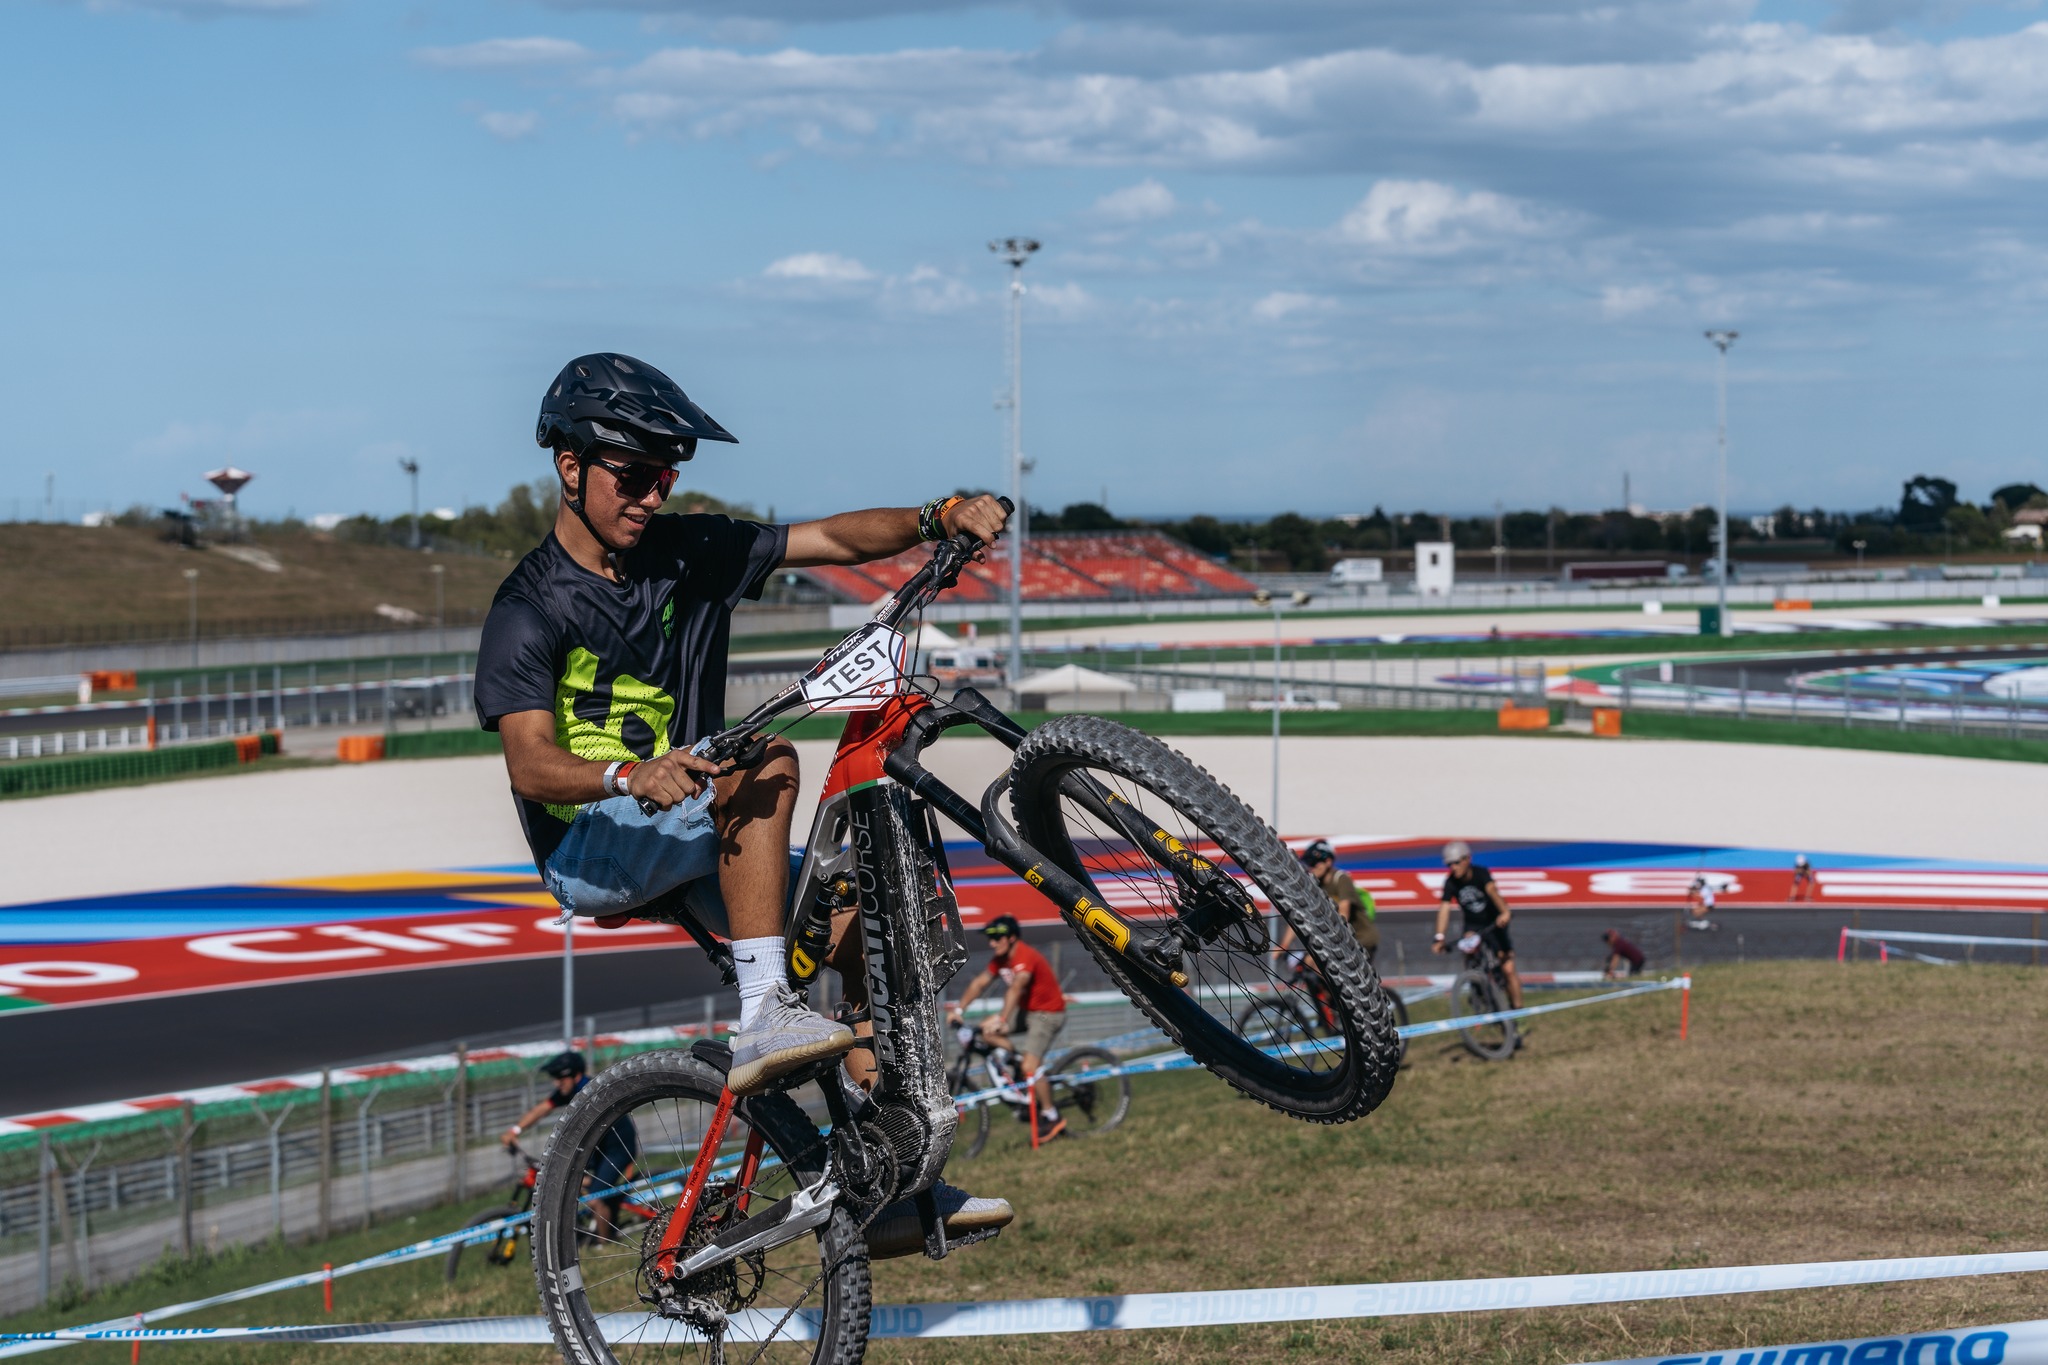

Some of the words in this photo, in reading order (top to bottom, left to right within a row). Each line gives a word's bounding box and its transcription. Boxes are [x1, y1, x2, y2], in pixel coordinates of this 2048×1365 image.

[822, 640, 887, 693] TEST
[826, 631, 865, 661] THOK
[854, 811, 880, 915] CORSE
[864, 917, 897, 1063] DUCATI
[680, 1189, 693, 1209] TPS
[689, 1171, 700, 1187] THOK
[697, 1127, 717, 1169] PROGRESSIVE
[714, 1102, 726, 1126] SYSTEM
[547, 1268, 590, 1365] PIRELLI
